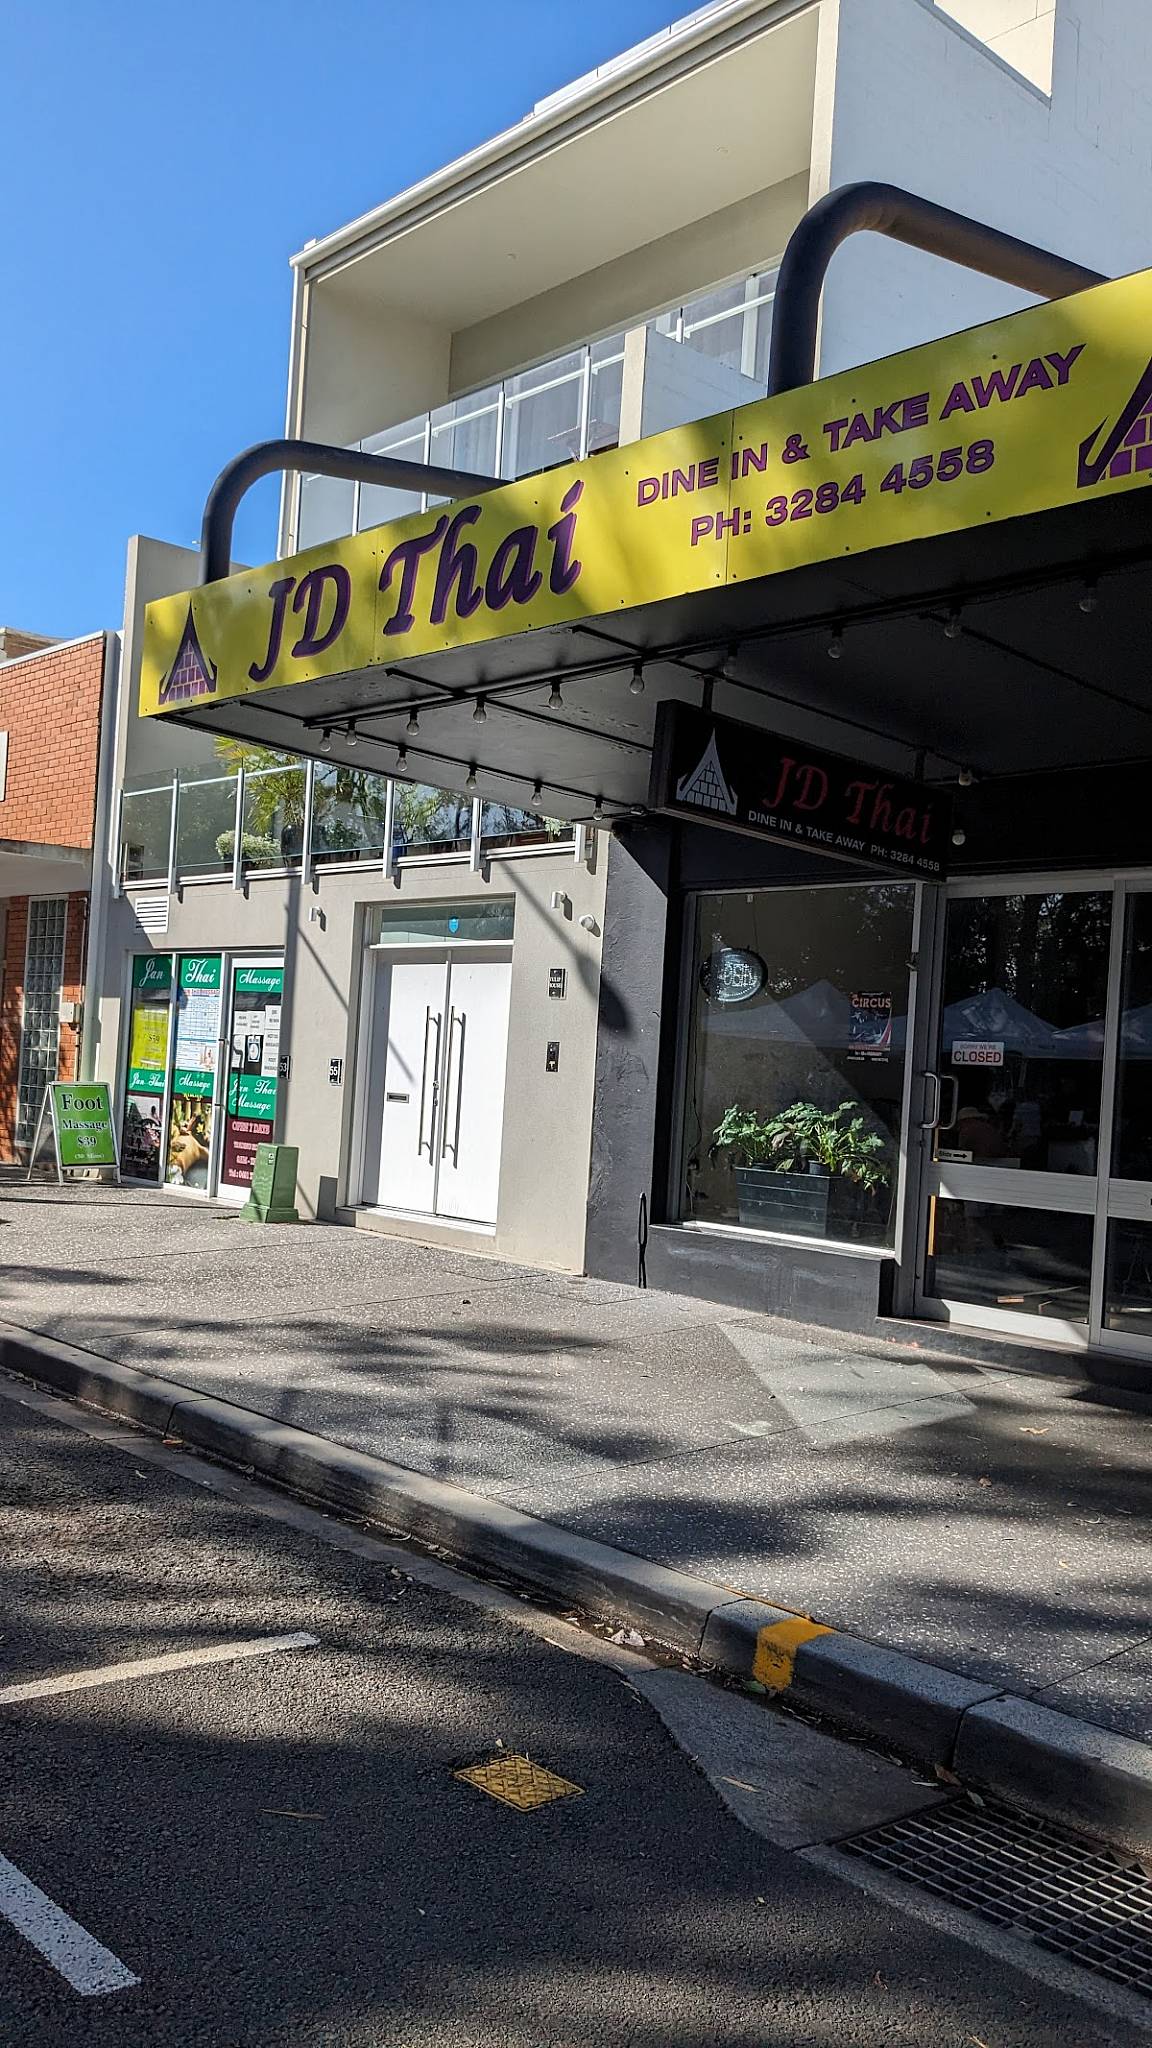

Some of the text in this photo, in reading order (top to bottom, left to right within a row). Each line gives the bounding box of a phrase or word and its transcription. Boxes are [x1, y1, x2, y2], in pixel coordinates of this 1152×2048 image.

[637, 343, 1087, 508] DINE IN & TAKE AWAY
[690, 440, 996, 547] PH: 3284 4558
[248, 479, 585, 684] JD Thai
[762, 756, 935, 844] JD Thai
[748, 810, 940, 872] DINE IN & TAKE AWAY PH: 3284 4558
[139, 957, 281, 991] Jan Thai Massage
[852, 998, 891, 1009] CIRCUS
[954, 1051, 1001, 1063] CLOSED
[330, 1066, 338, 1076] 55
[179, 1073, 211, 1093] Massage
[61, 1093, 104, 1111] Foot
[232, 1095, 271, 1115] Massage
[62, 1120, 108, 1132] Massage
[77, 1136, 97, 1147] $39
